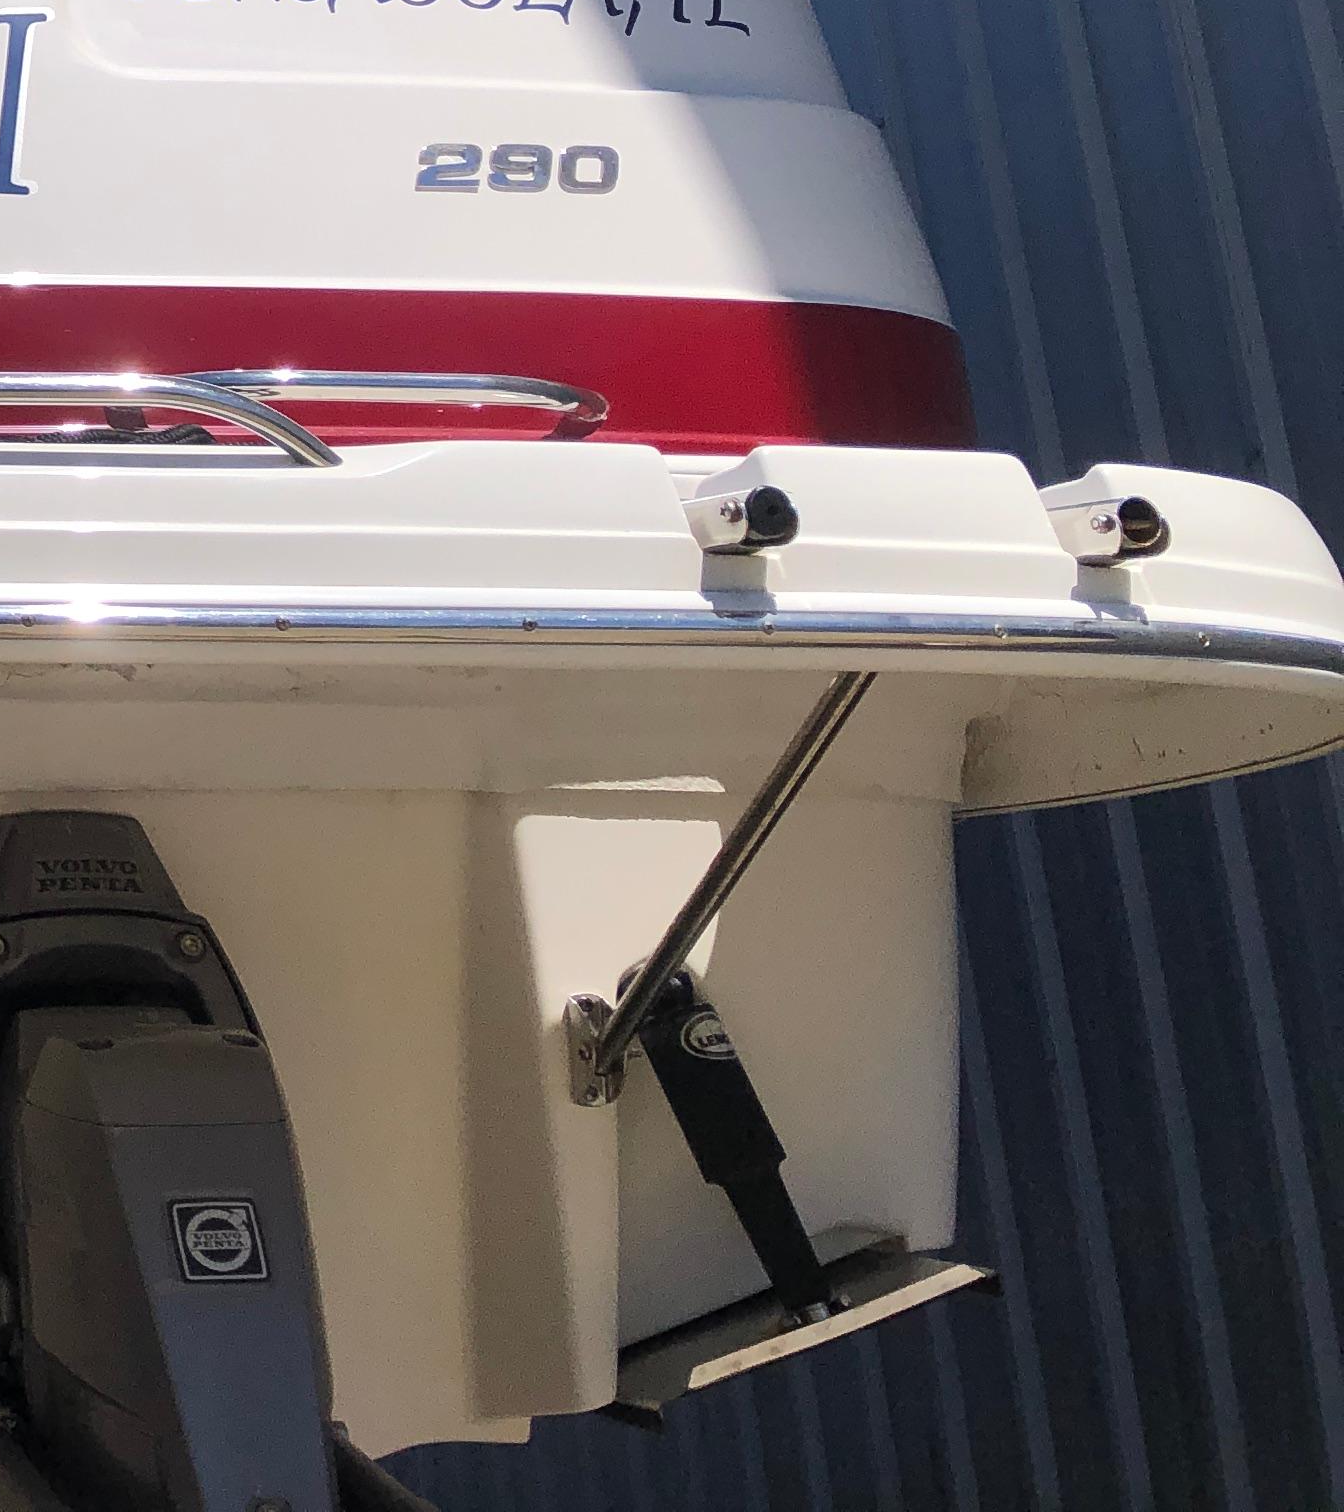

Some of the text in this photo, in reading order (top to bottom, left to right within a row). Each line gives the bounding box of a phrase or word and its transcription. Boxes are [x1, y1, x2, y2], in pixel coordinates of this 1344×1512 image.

[414, 142, 619, 195] 290
[36, 859, 138, 875] VOLVO
[37, 877, 144, 894] PENTA
[192, 1240, 246, 1248] PENTA
[193, 1232, 242, 1240] VOLVO
